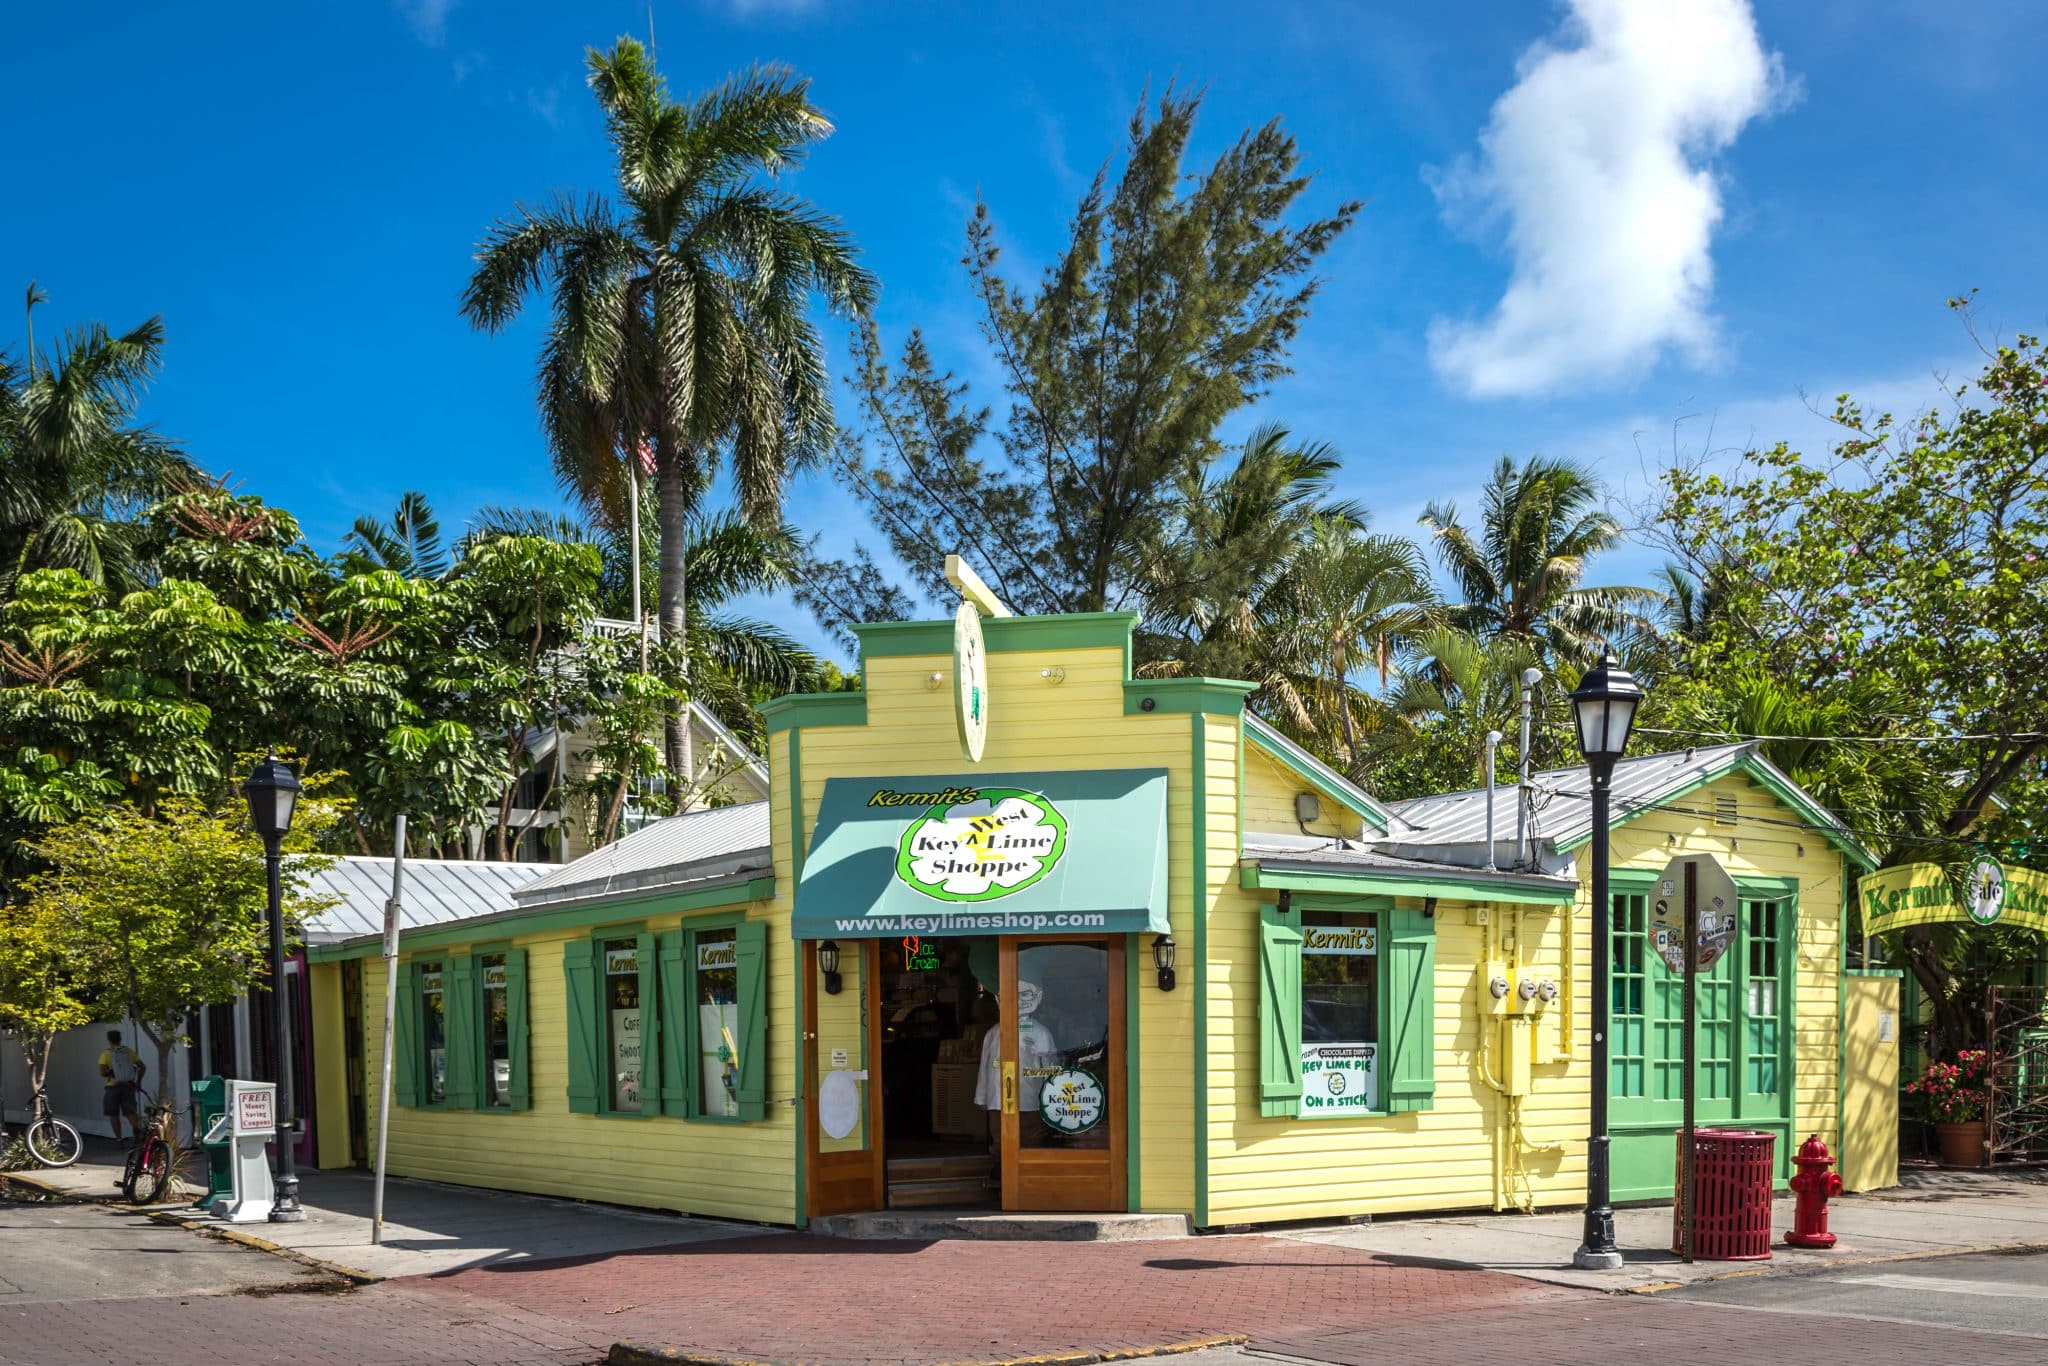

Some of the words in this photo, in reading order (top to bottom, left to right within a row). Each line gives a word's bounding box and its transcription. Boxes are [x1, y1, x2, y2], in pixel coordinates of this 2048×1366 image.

[867, 787, 979, 807] Kermit's
[969, 808, 1030, 833] West
[918, 836, 963, 855] Key
[987, 834, 1052, 849] Lime
[931, 859, 1028, 878] Shoppe
[835, 911, 1105, 934] www.keylimeshop.com
[1304, 928, 1375, 949] Kermit's
[910, 956, 940, 969] Cream
[1302, 1060, 1322, 1074] KEY
[1061, 1083, 1086, 1096] West
[242, 1094, 268, 1102] FREE
[1049, 1094, 1067, 1105] Key
[1071, 1094, 1097, 1104] Lime
[1327, 1098, 1334, 1107] A
[1338, 1093, 1368, 1106] STICK
[1055, 1107, 1092, 1118] Shoppe
